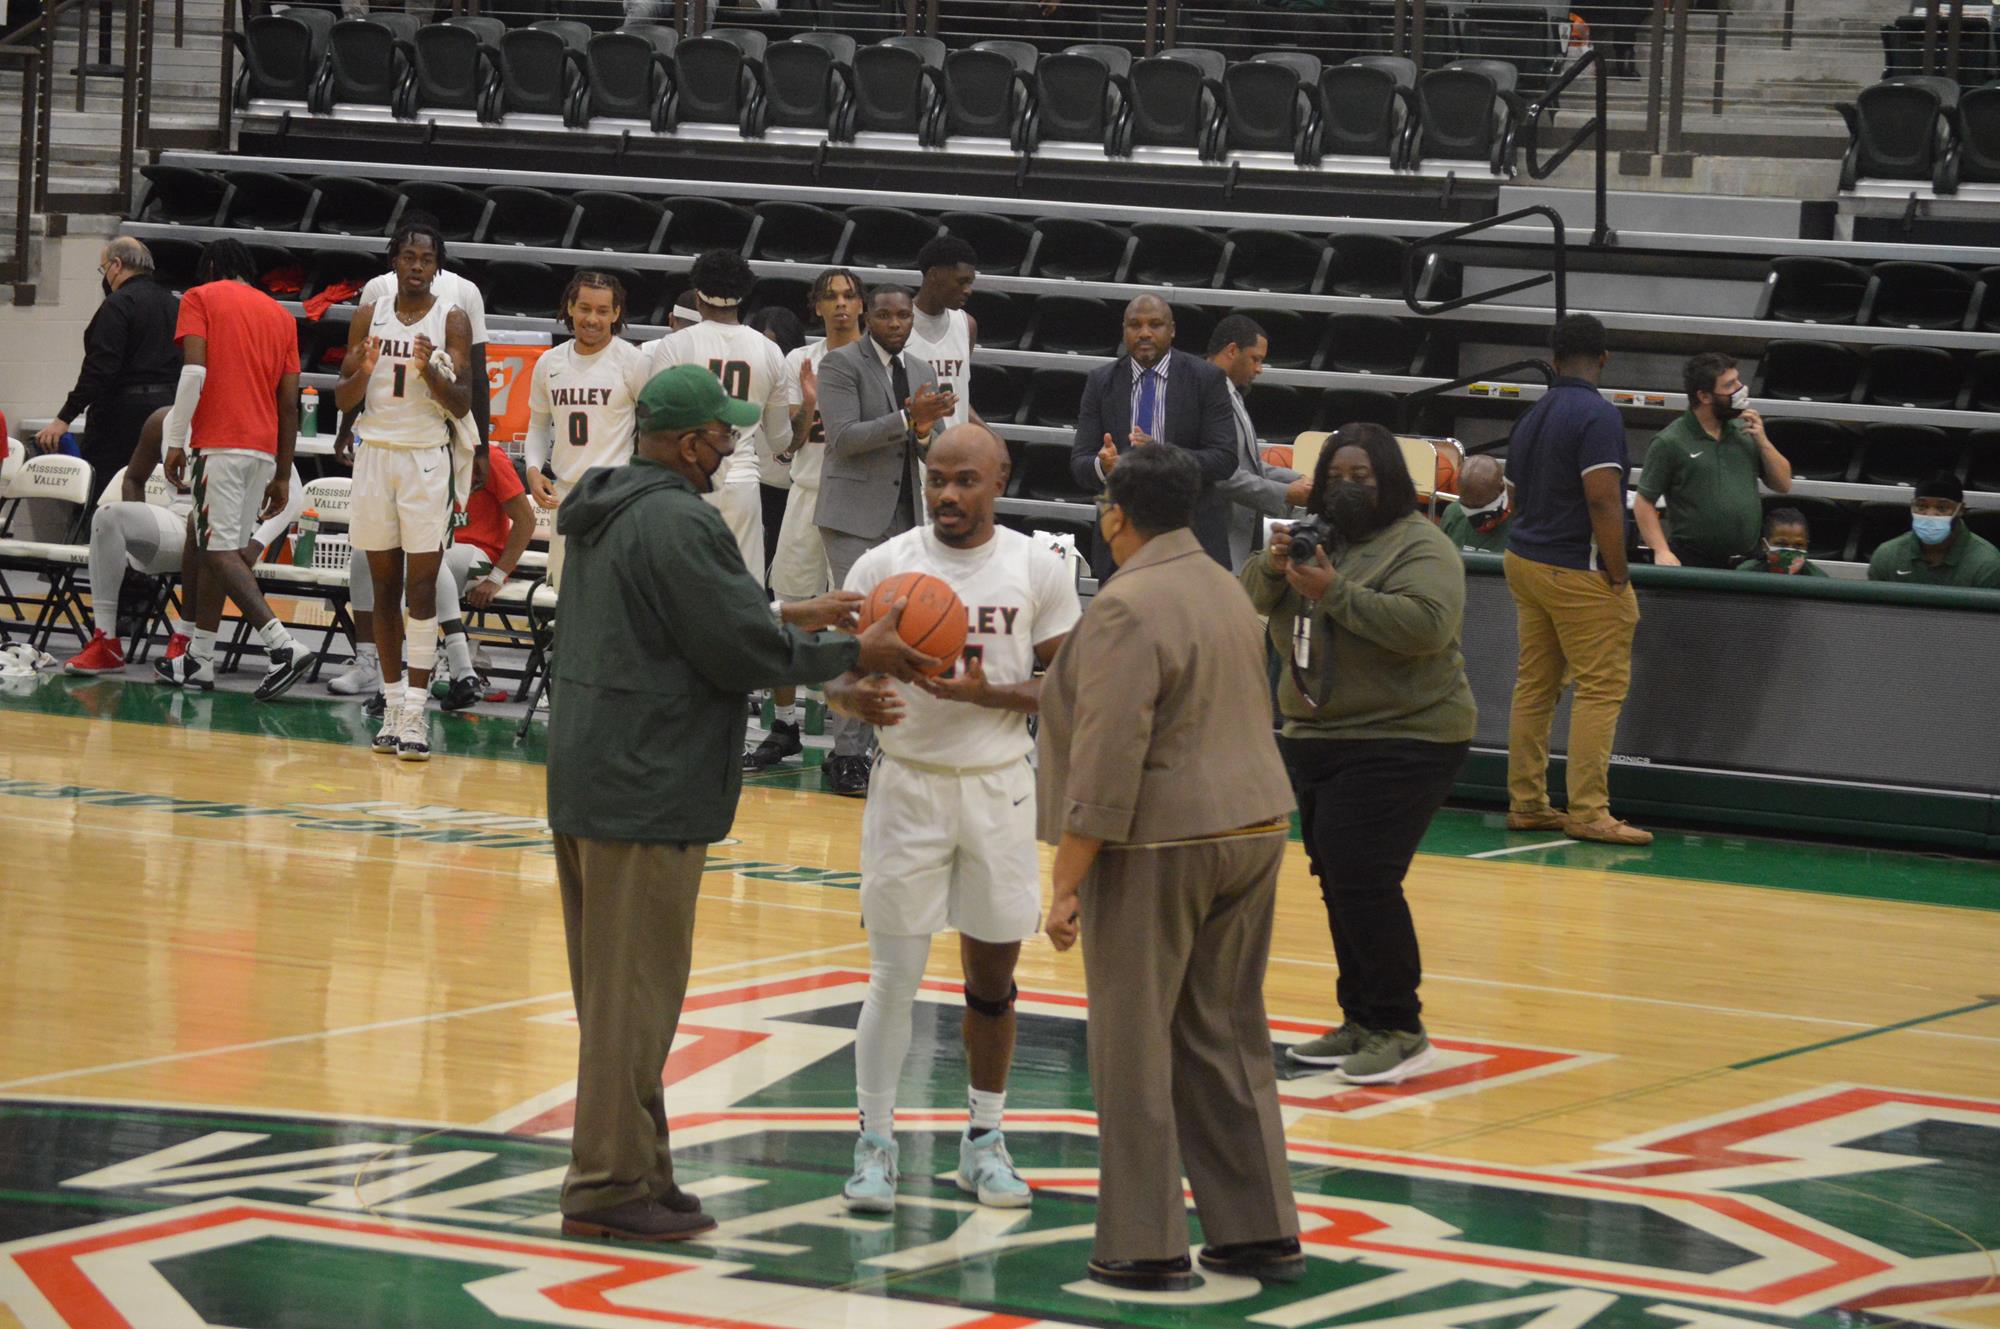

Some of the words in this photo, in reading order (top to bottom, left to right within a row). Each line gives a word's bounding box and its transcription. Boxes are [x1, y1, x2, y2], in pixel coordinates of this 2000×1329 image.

[927, 359, 963, 377] LLEY
[393, 363, 407, 398] 1
[551, 388, 612, 406] VALLEY
[569, 411, 588, 446] 0
[967, 606, 1019, 635] LEY
[1610, 754, 1651, 765] RONICS
